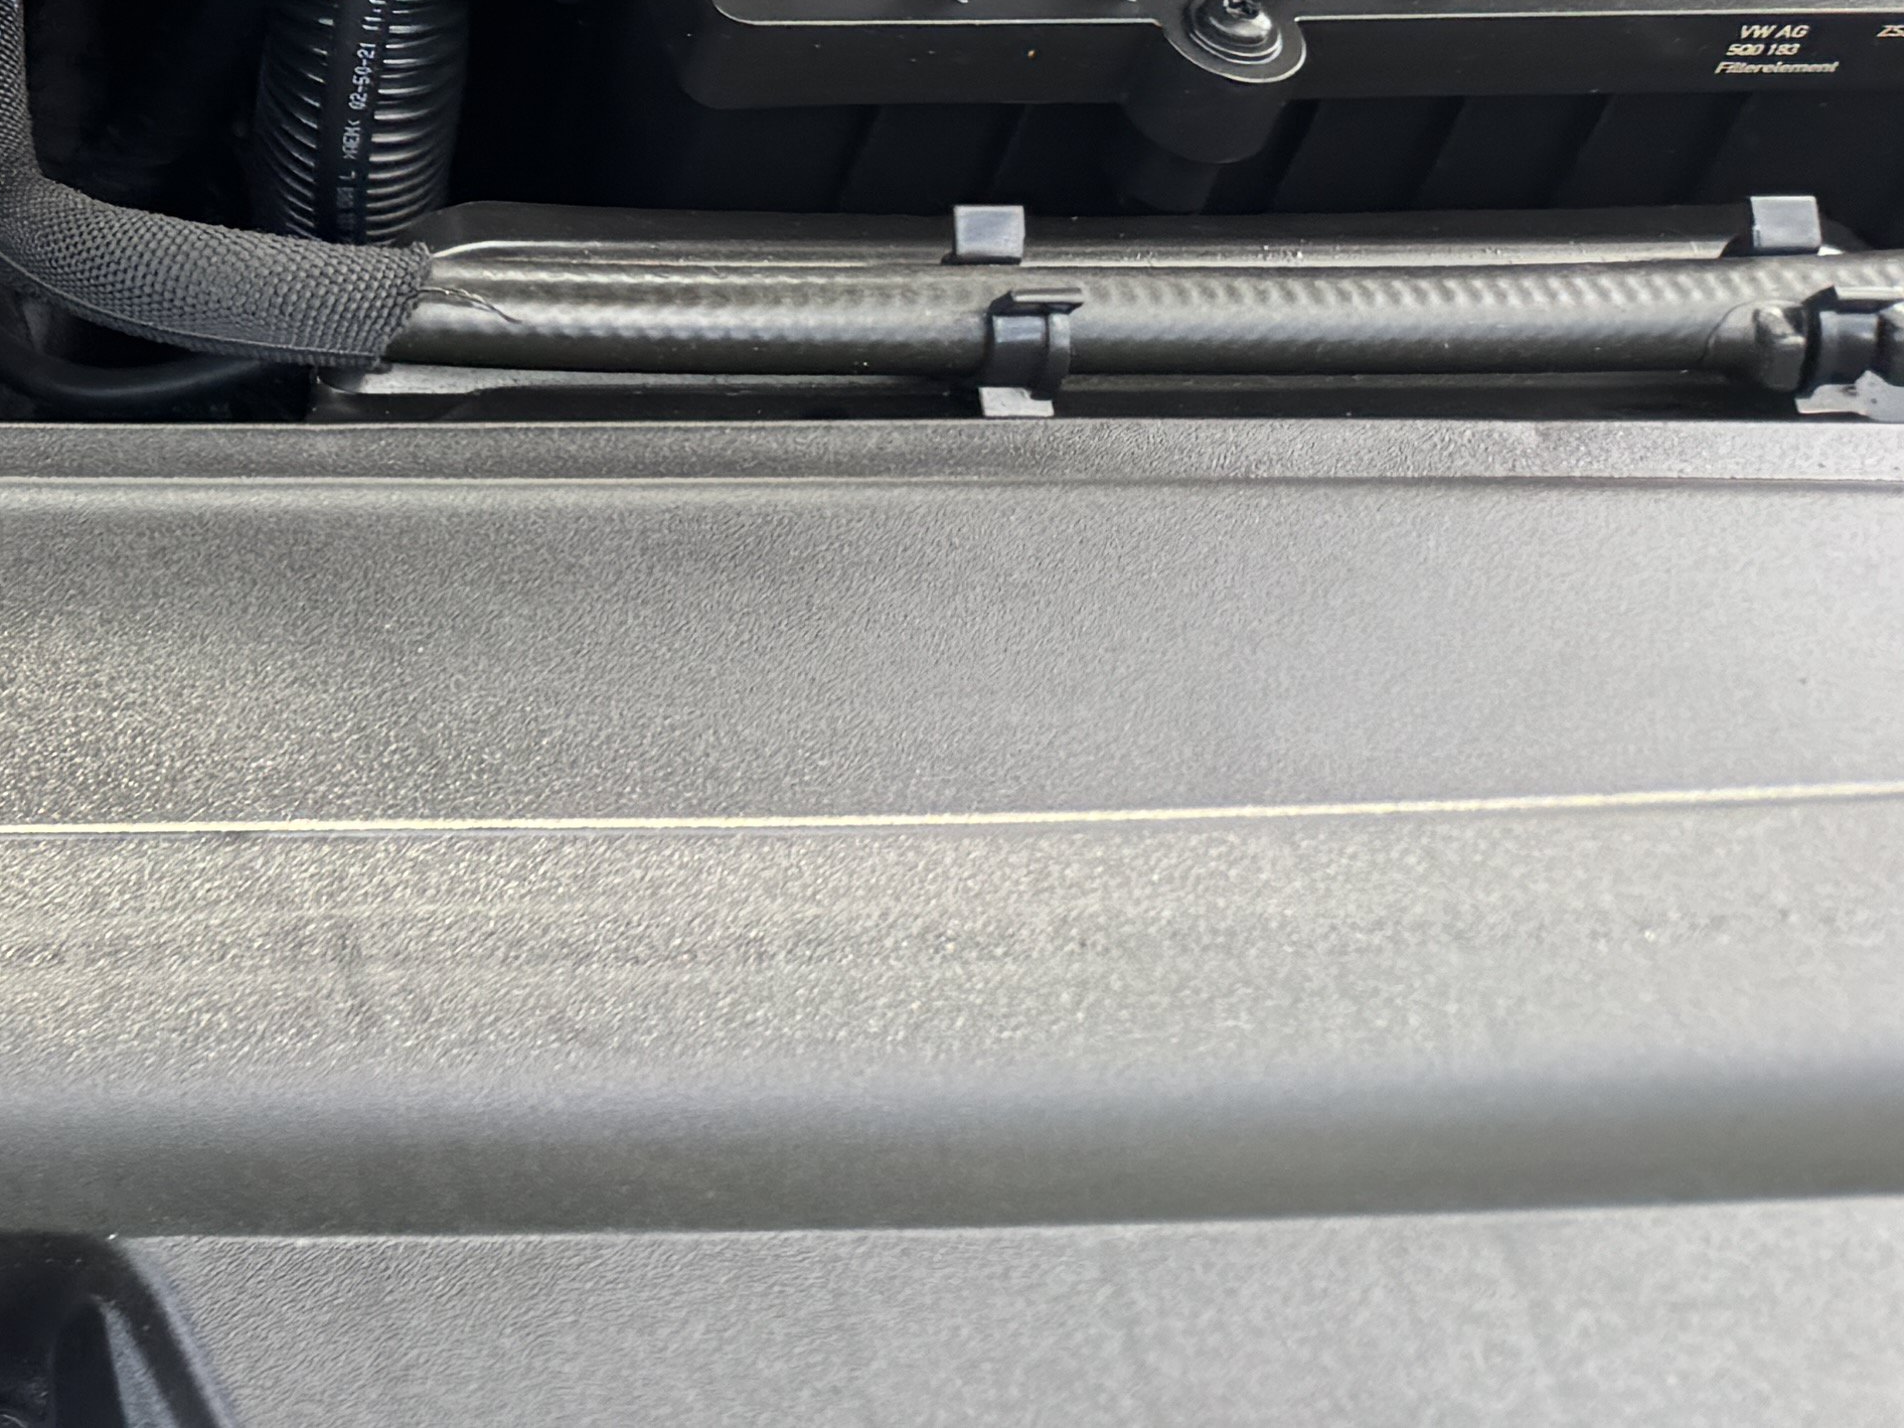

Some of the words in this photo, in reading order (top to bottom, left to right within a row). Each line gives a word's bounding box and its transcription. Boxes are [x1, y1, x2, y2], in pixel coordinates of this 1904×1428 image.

[1739, 24, 1777, 39] VW
[1775, 24, 1810, 38] AG
[348, 41, 377, 111] 02-50-21
